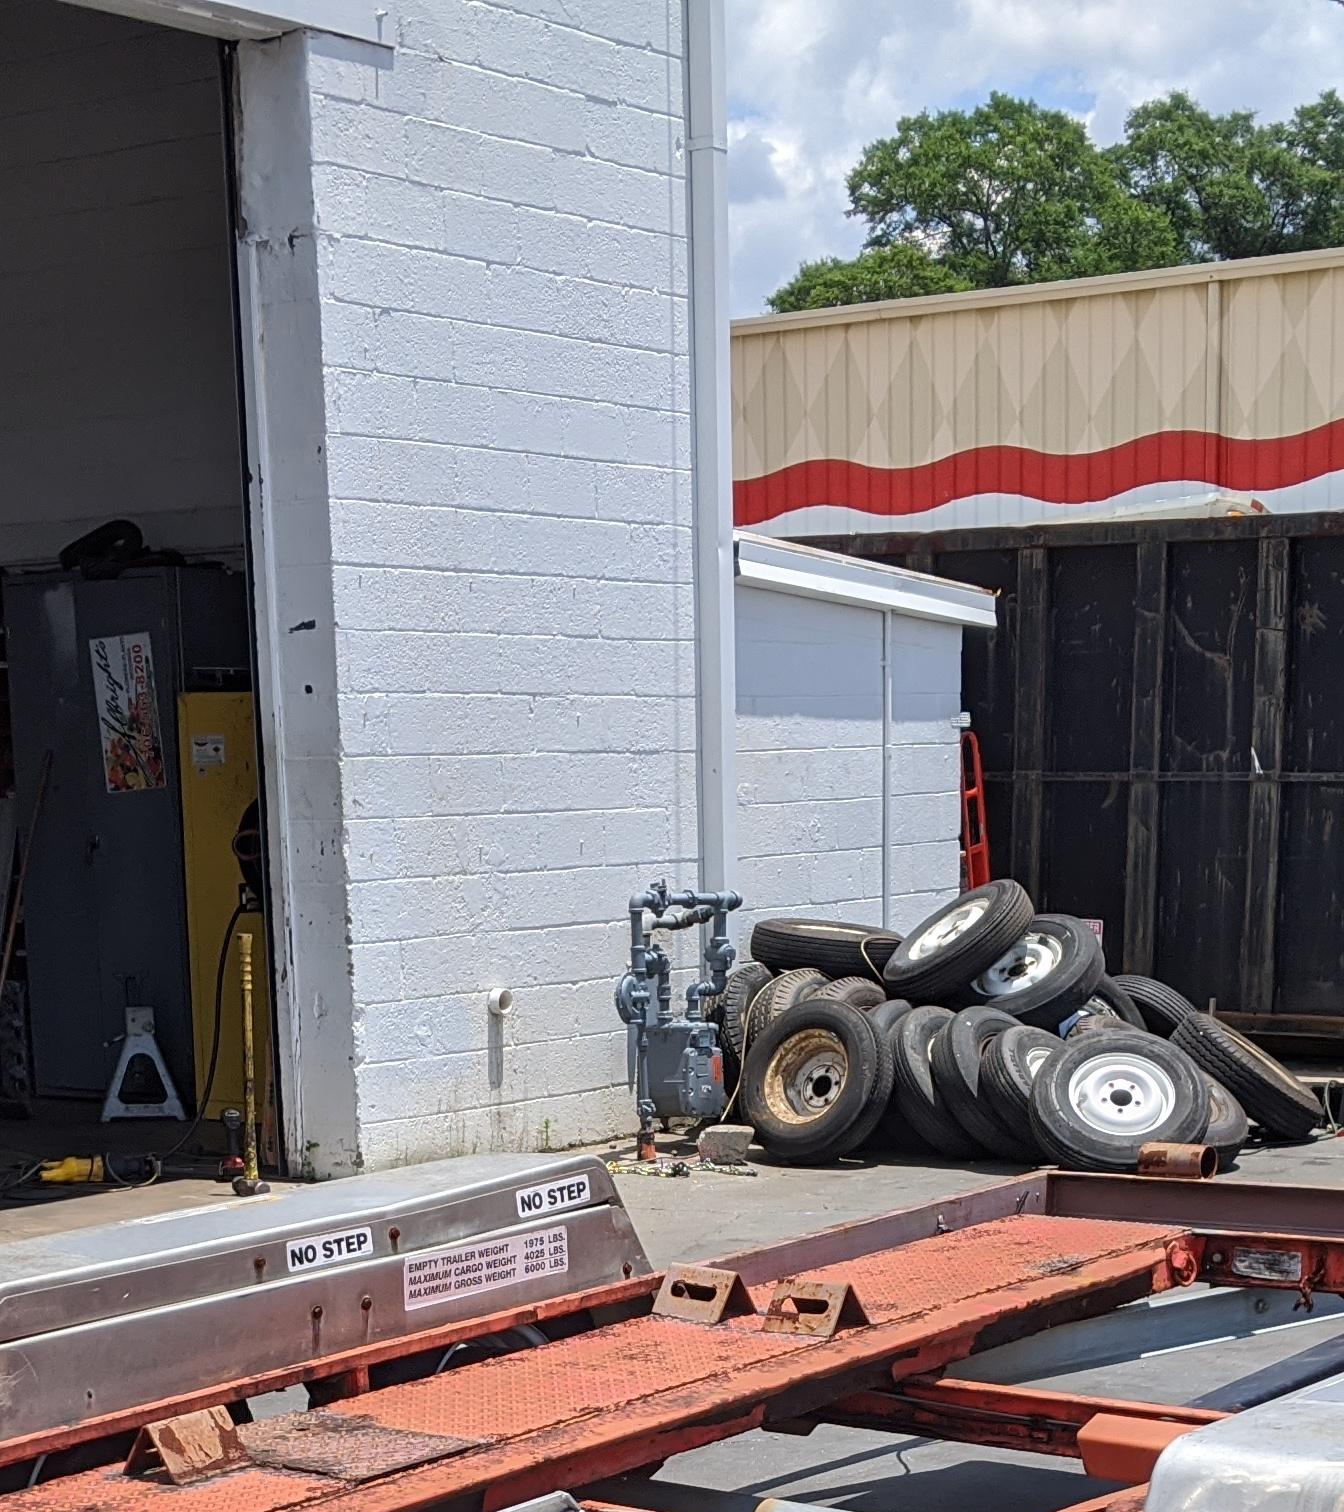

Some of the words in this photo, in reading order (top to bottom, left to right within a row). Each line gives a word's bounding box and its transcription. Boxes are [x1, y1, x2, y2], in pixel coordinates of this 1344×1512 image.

[519, 1192, 543, 1213] NO
[547, 1181, 587, 1206] STEP
[290, 1246, 317, 1267] NO
[323, 1232, 368, 1259] STEP
[408, 1258, 439, 1273] EMPTY
[441, 1251, 476, 1269] TRAILER
[477, 1243, 510, 1259] WEIGHT
[524, 1236, 545, 1249] 1975
[548, 1232, 566, 1244] LBS.
[408, 1268, 452, 1286] MAXIMUM
[454, 1262, 483, 1277] CARGO
[485, 1255, 517, 1270] WEIGHT
[524, 1248, 545, 1261] 4025
[548, 1244, 566, 1256] LBS.
[408, 1281, 452, 1299] MAXIMUM
[454, 1275, 483, 1290] GROSS
[485, 1267, 517, 1283] WEIGHT
[524, 1261, 546, 1274] 6000
[549, 1257, 567, 1269] LBS.
